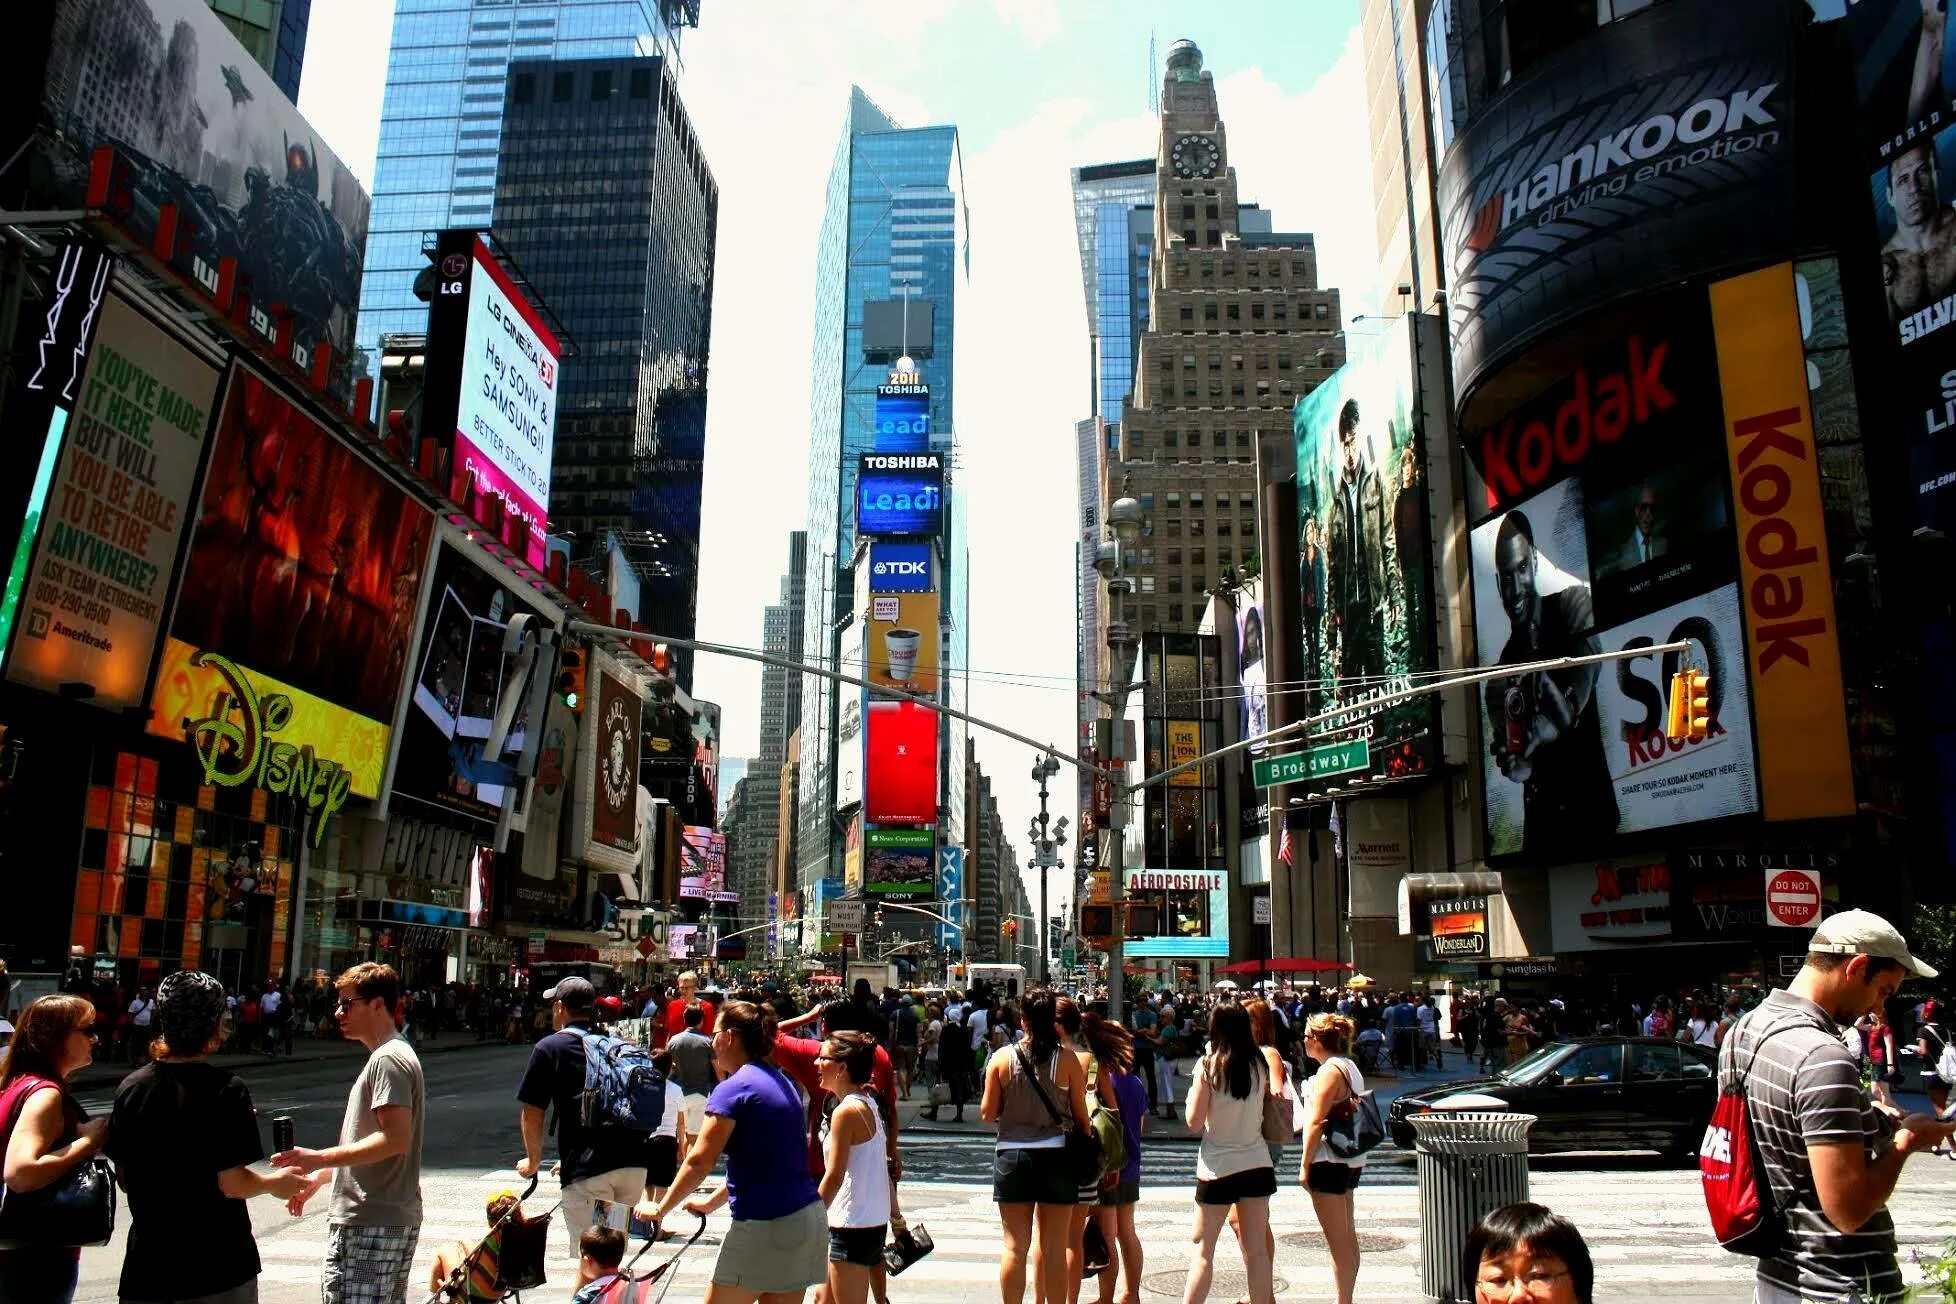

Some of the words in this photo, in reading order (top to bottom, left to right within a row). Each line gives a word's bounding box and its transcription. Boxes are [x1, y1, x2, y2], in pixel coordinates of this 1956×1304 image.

[1880, 111, 1940, 157] WORLD
[1538, 174, 1630, 229] driving
[1633, 128, 1780, 182] emotion
[441, 282, 462, 294] LG
[487, 294, 501, 322] LG
[95, 342, 160, 411] YOU'VE
[157, 385, 203, 438] MADE
[486, 338, 506, 380] Hey
[510, 366, 539, 415] SONY
[540, 401, 549, 425] &
[878, 385, 929, 394] TOSHIBA
[890, 373, 919, 384] 2011
[84, 377, 108, 414] IT
[483, 373, 544, 454] SAMSUNG!!
[1482, 335, 1676, 510] Kodak
[76, 413, 116, 459] BUT
[115, 434, 157, 487] WILL
[473, 414, 503, 454] BETTER
[505, 445, 526, 477] STICK
[526, 465, 537, 486] TO
[537, 477, 547, 497] 2D
[864, 456, 939, 469] TOSHIBA
[68, 447, 108, 494] YOU
[107, 469, 134, 509] BE
[133, 486, 177, 533] ABLE
[862, 487, 939, 510] Leadi
[58, 482, 86, 524] TO
[87, 495, 152, 556] RETIRE
[1732, 406, 1827, 675] Kodak
[46, 520, 159, 597] ANYWHERE?
[886, 562, 926, 574] TDK
[40, 558, 66, 588] ASK
[65, 566, 98, 599] TEAM
[52, 620, 113, 653] Ameritrade
[1616, 616, 1727, 740] SO
[1368, 672, 1412, 715] ENDS
[1172, 744, 1196, 760] LION
[1175, 733, 1193, 742] THE
[1271, 751, 1351, 779] Broadway
[1621, 785, 1641, 796] SHARE
[1641, 780, 1657, 792] YOUR
[1658, 780, 1667, 788] SO
[1667, 775, 1689, 786] KODAK
[1689, 768, 1718, 783] MOMENT
[1718, 763, 1738, 774] HERE
[895, 835, 929, 843] Corporation
[1356, 843, 1400, 854] Marriott
[1688, 853, 1838, 869] MARQUIS
[1775, 881, 1789, 891] DO
[1791, 881, 1810, 891] NOT
[1431, 900, 1485, 914] MARQUIS
[1778, 906, 1809, 916] ENTER
[1433, 934, 1484, 955] WONDERLAND
[1506, 964, 1548, 975] sunglass
